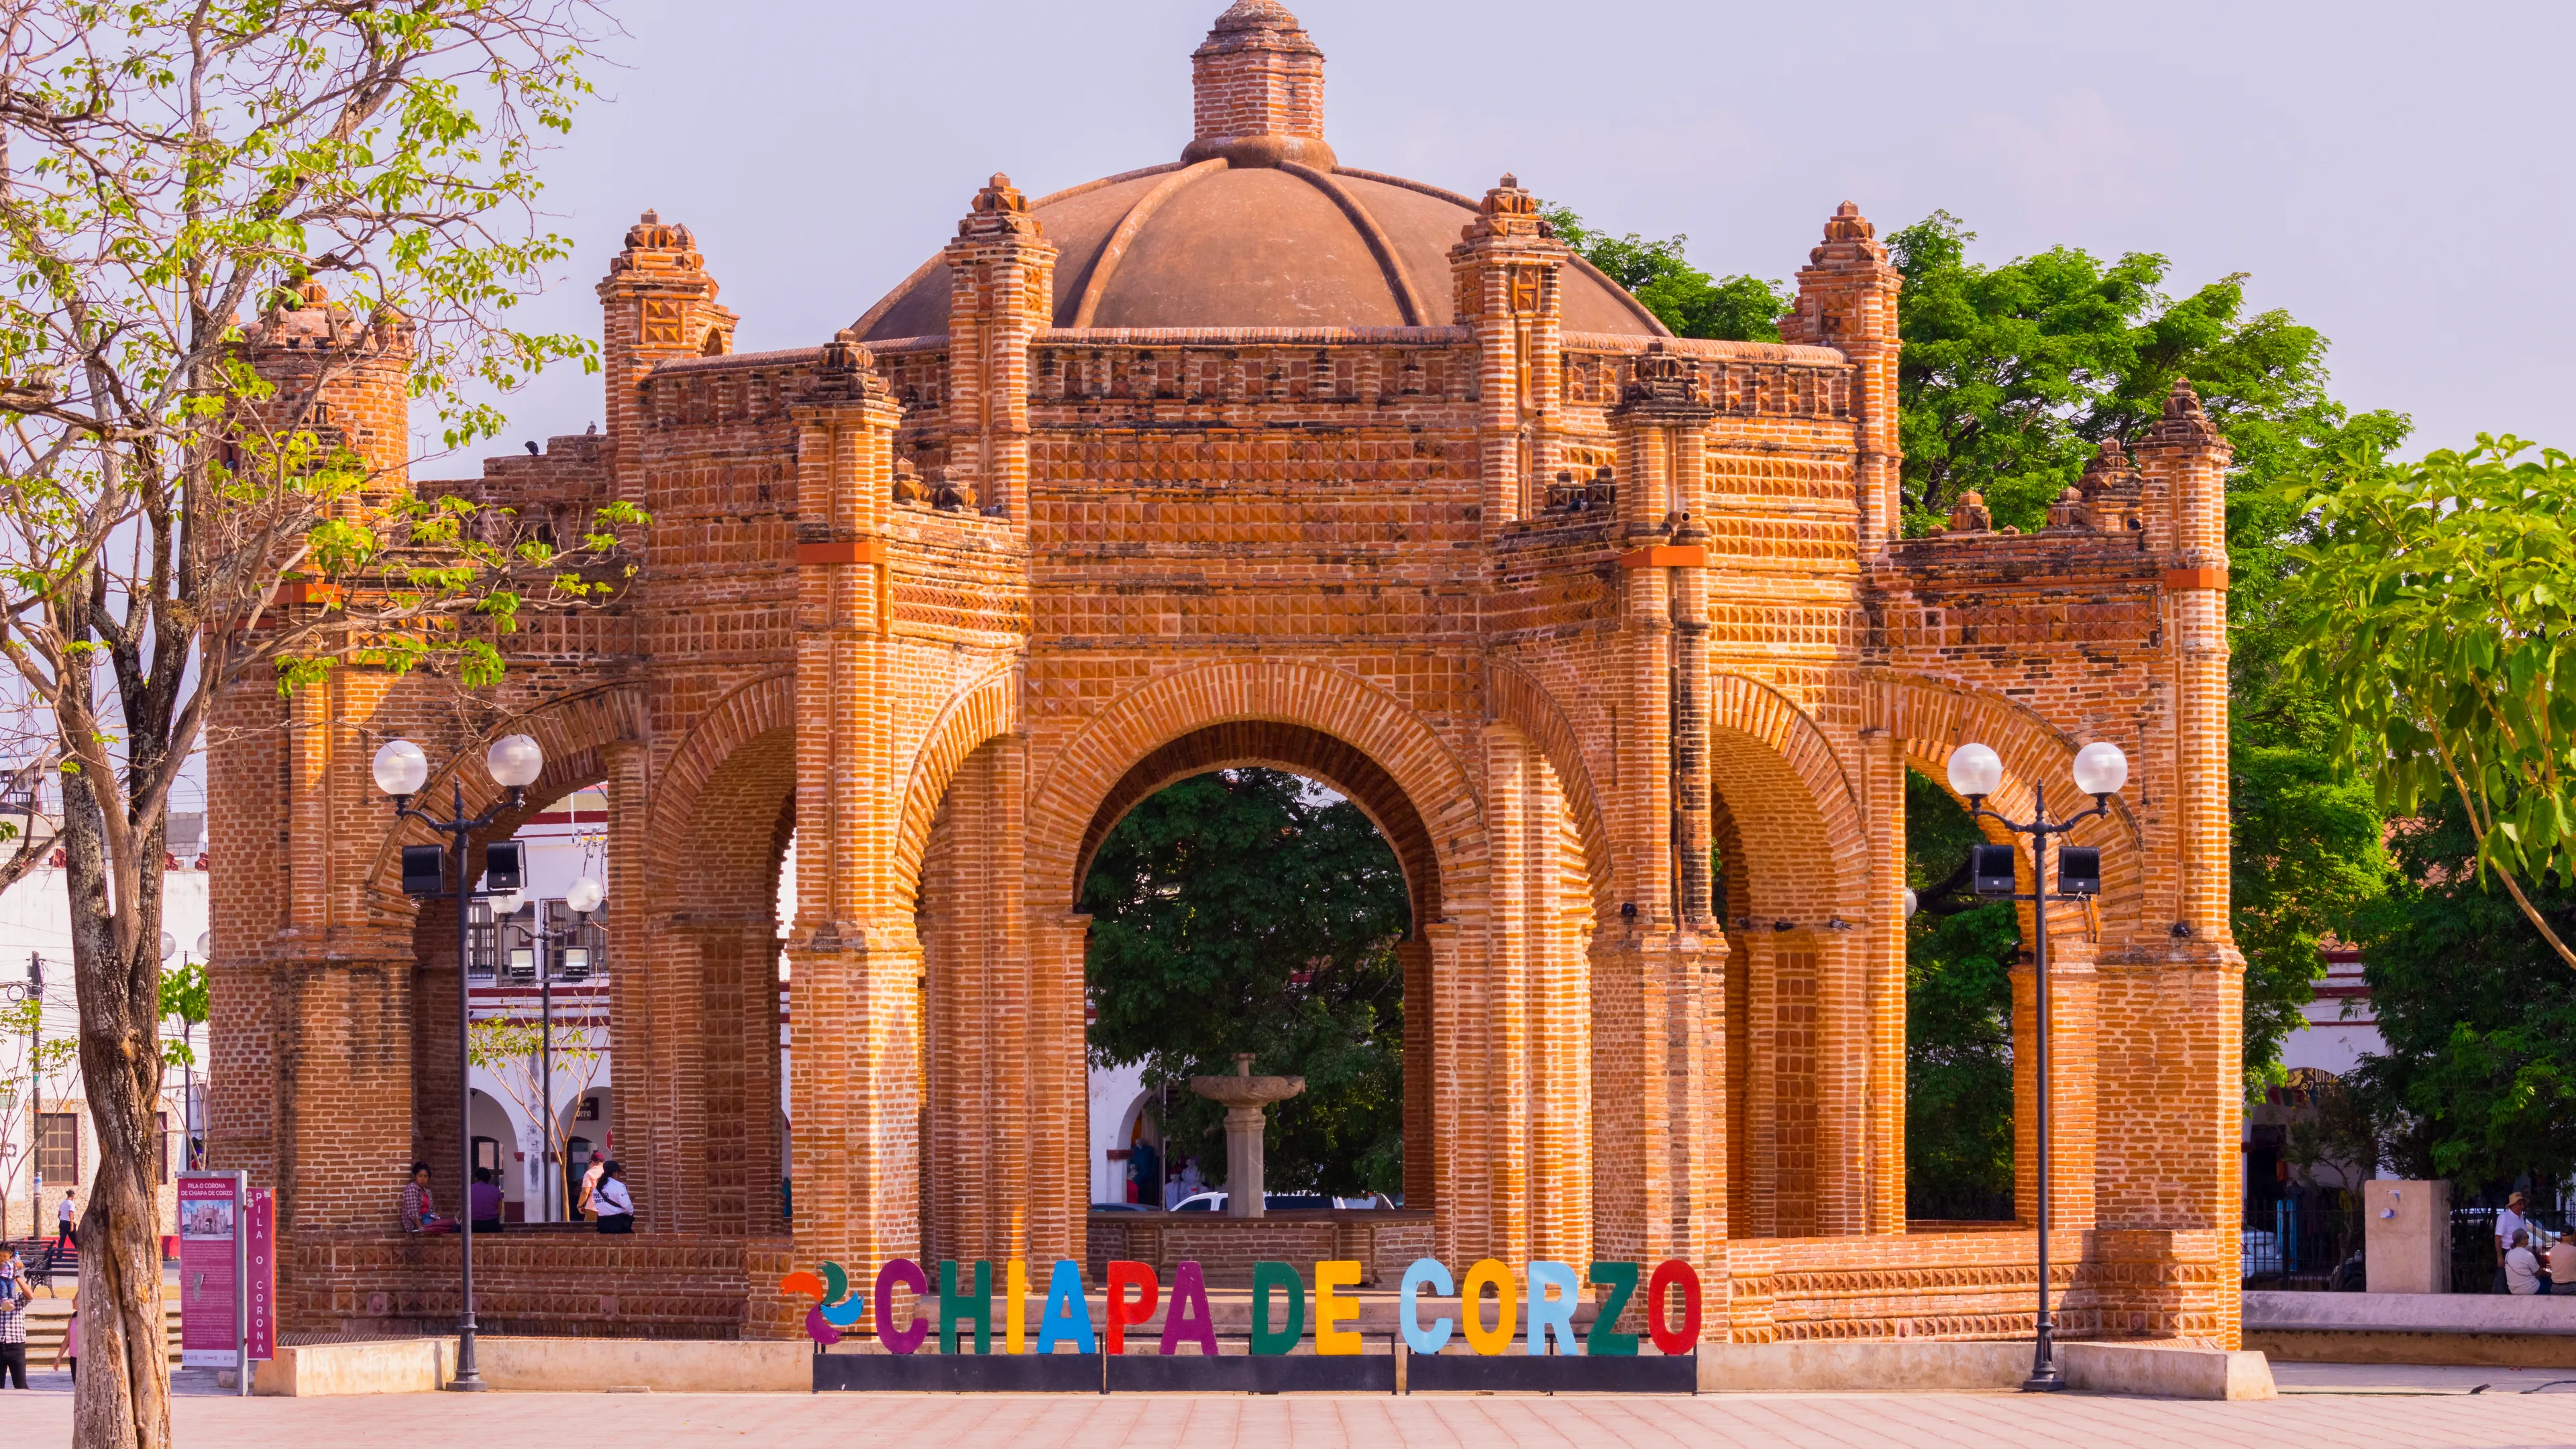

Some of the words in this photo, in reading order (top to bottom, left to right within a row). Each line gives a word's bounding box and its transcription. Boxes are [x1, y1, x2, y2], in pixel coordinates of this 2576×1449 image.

[256, 1256, 264, 1265] O
[256, 1281, 264, 1352] CORONA
[875, 1258, 1218, 1355] CHIAPA
[1252, 1260, 1362, 1355] DE
[1399, 1258, 1701, 1355] CORZO
